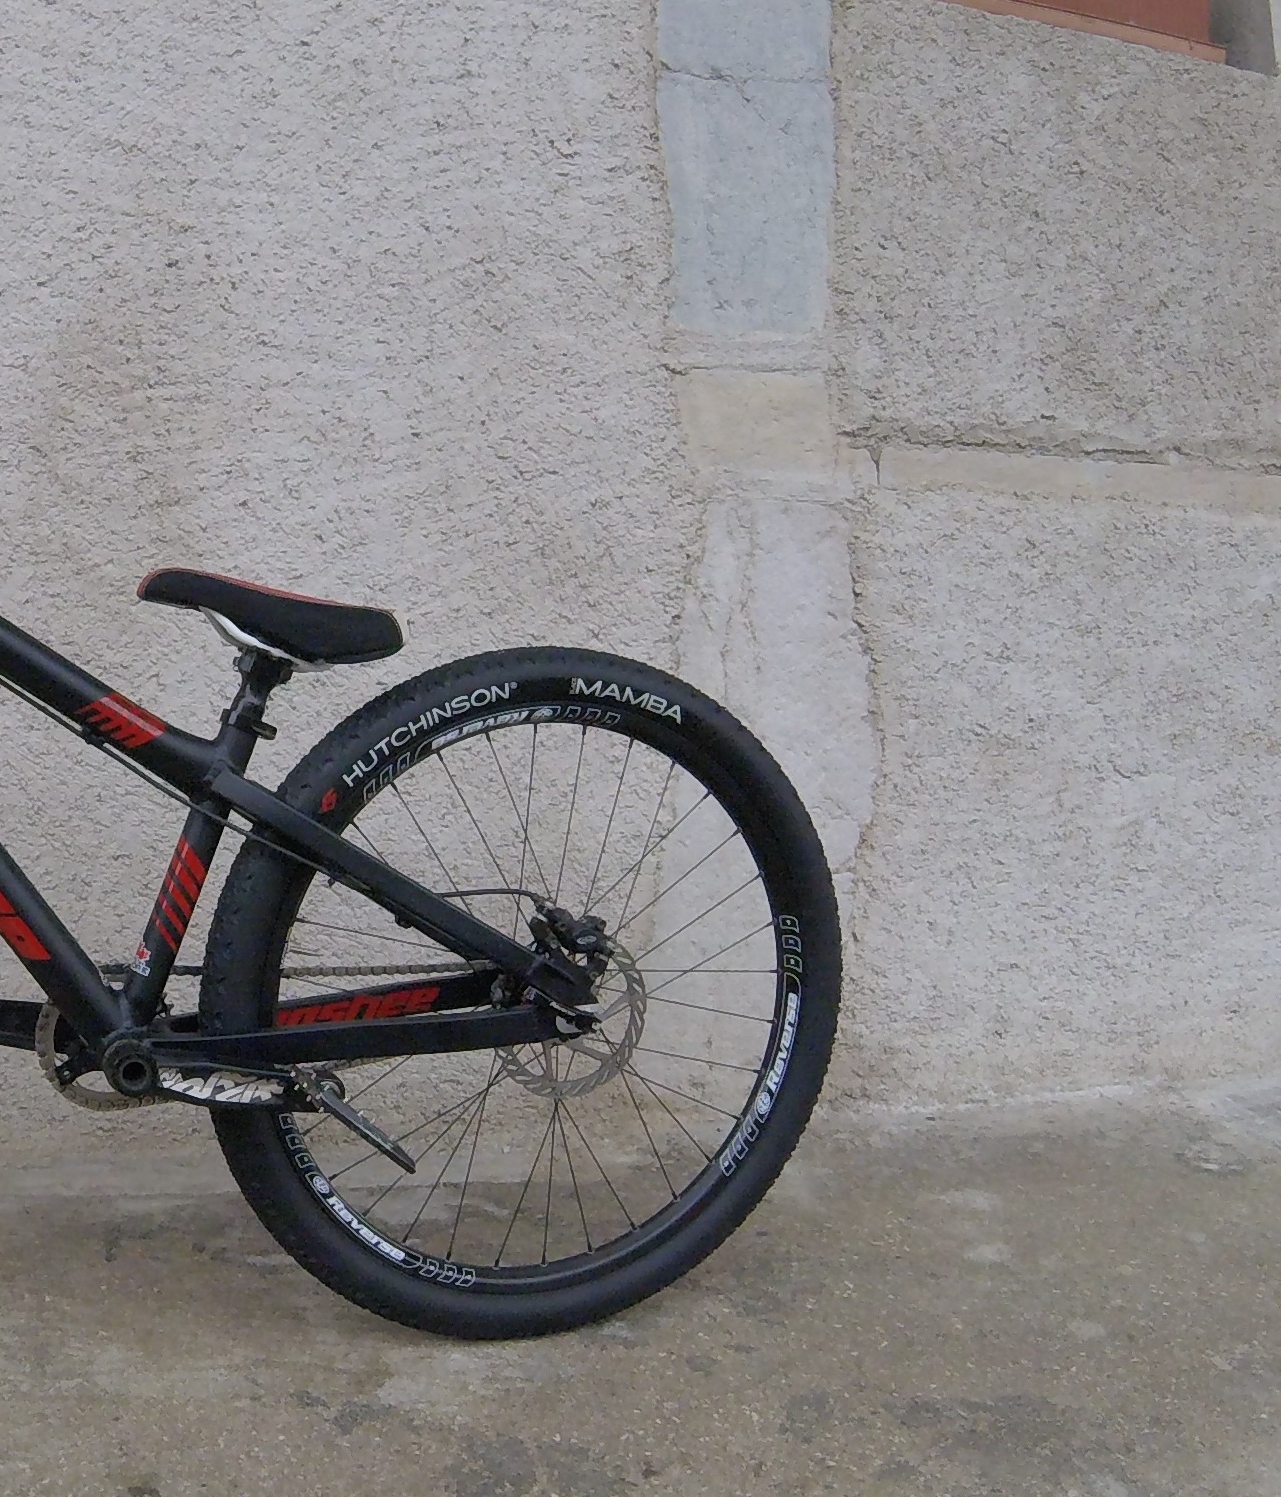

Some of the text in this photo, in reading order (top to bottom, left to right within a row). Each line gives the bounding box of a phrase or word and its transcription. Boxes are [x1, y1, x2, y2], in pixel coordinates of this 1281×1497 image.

[341, 677, 682, 788] HUTCHINSON MAMBA
[767, 992, 799, 1091] Reverse
[326, 1196, 406, 1261] Reverse
